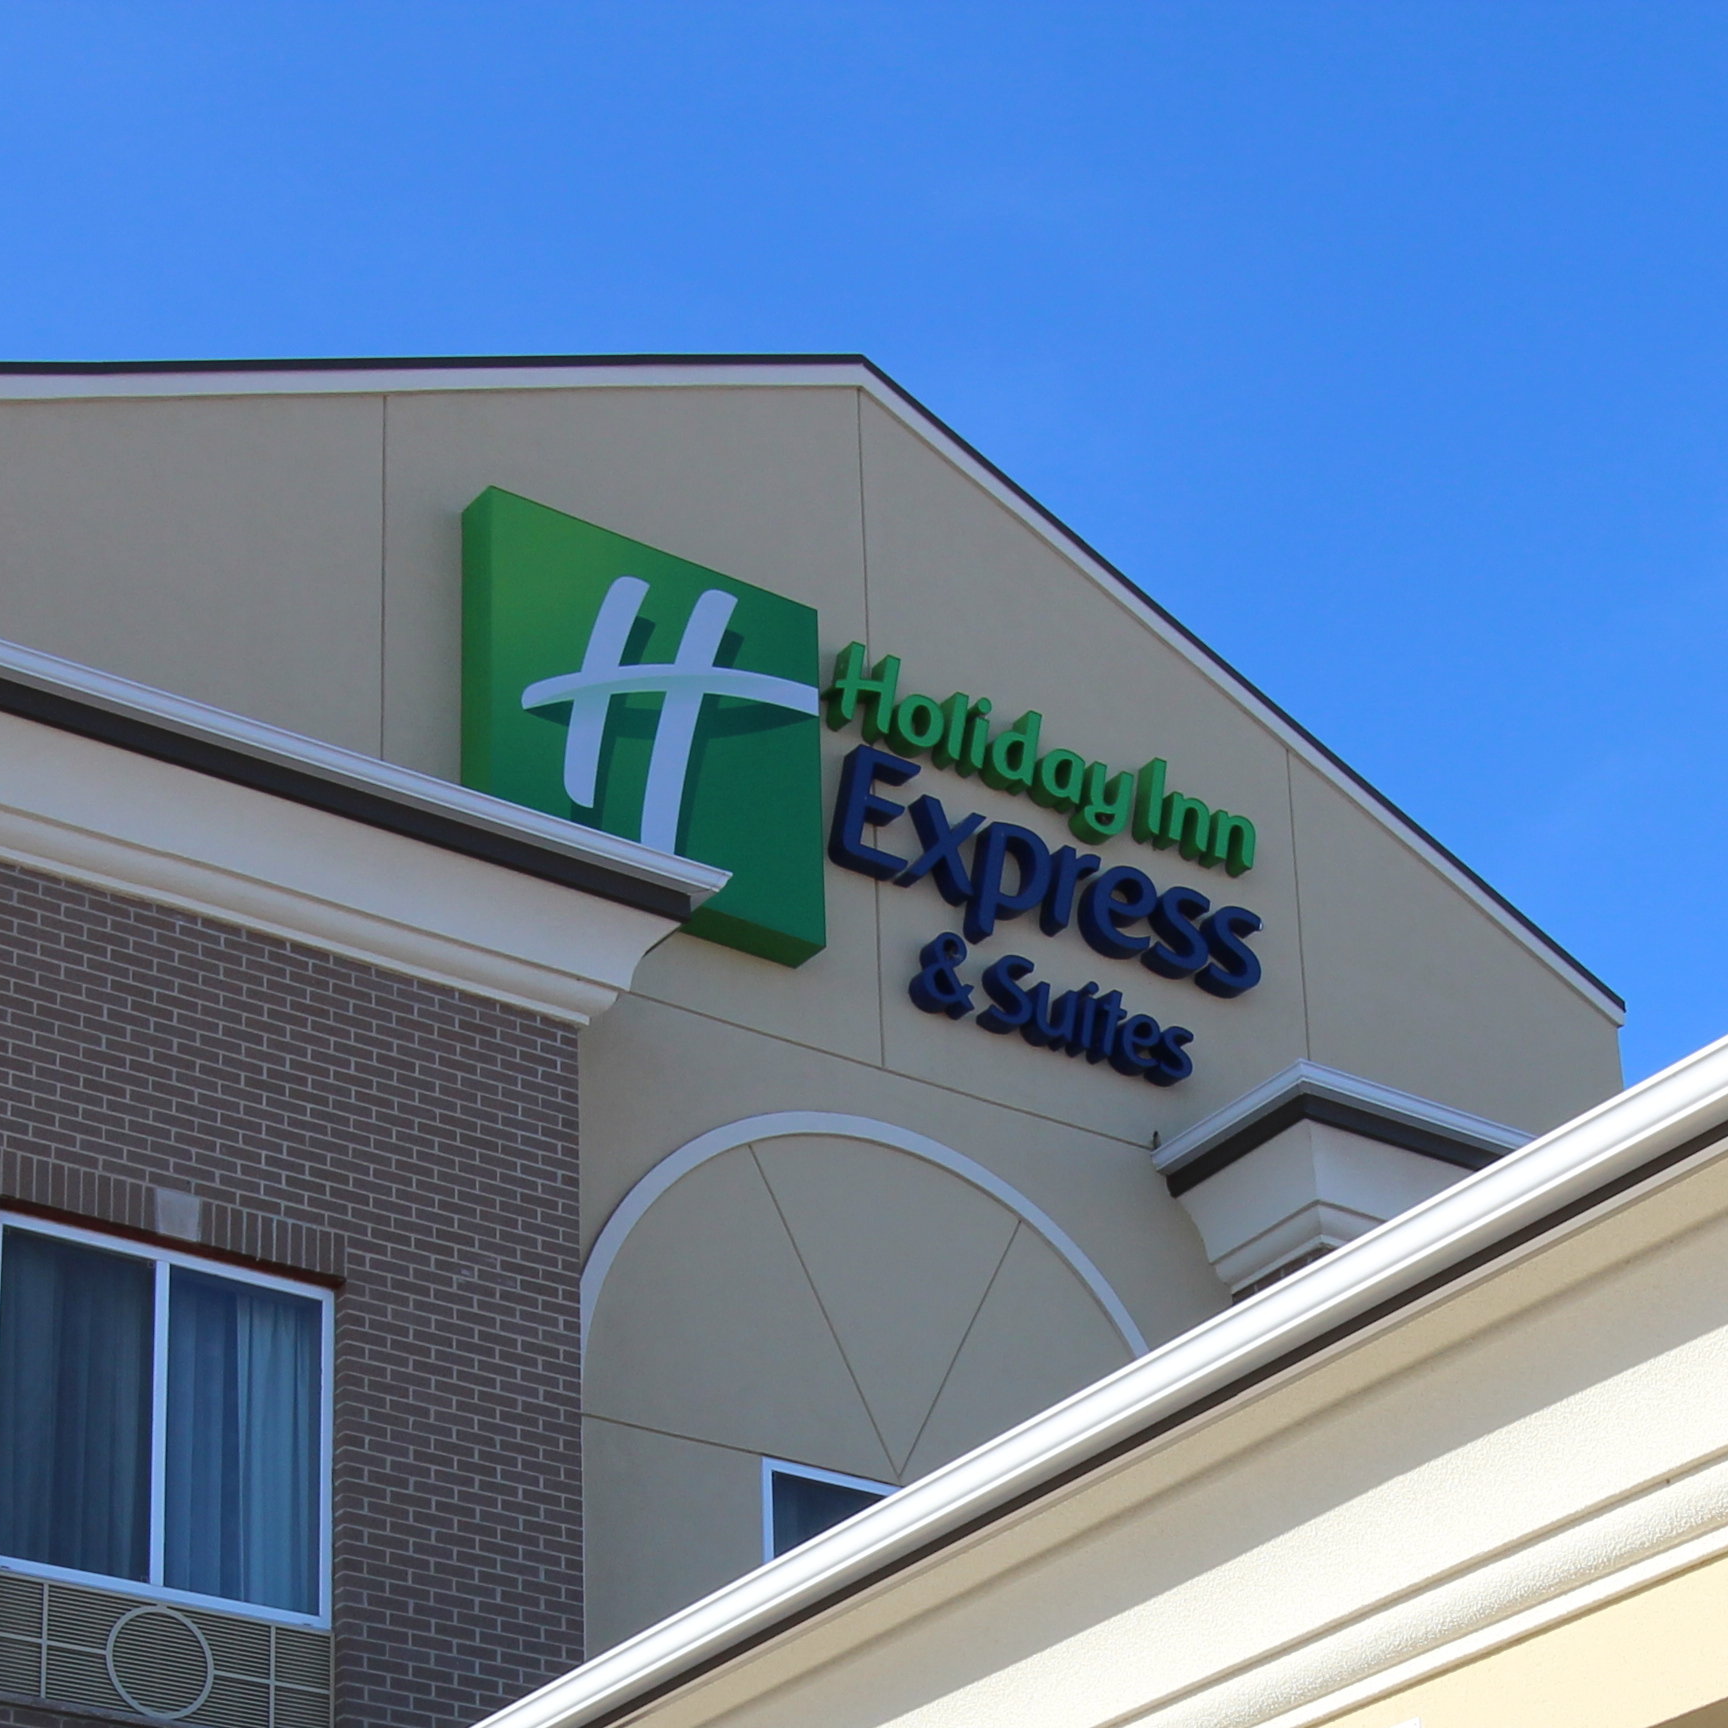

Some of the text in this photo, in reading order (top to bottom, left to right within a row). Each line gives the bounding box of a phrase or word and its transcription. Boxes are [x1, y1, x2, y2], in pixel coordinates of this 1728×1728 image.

[825, 641, 1256, 878] Holiday Inn
[828, 744, 1263, 998] Express
[908, 932, 1194, 1087] & Suites
